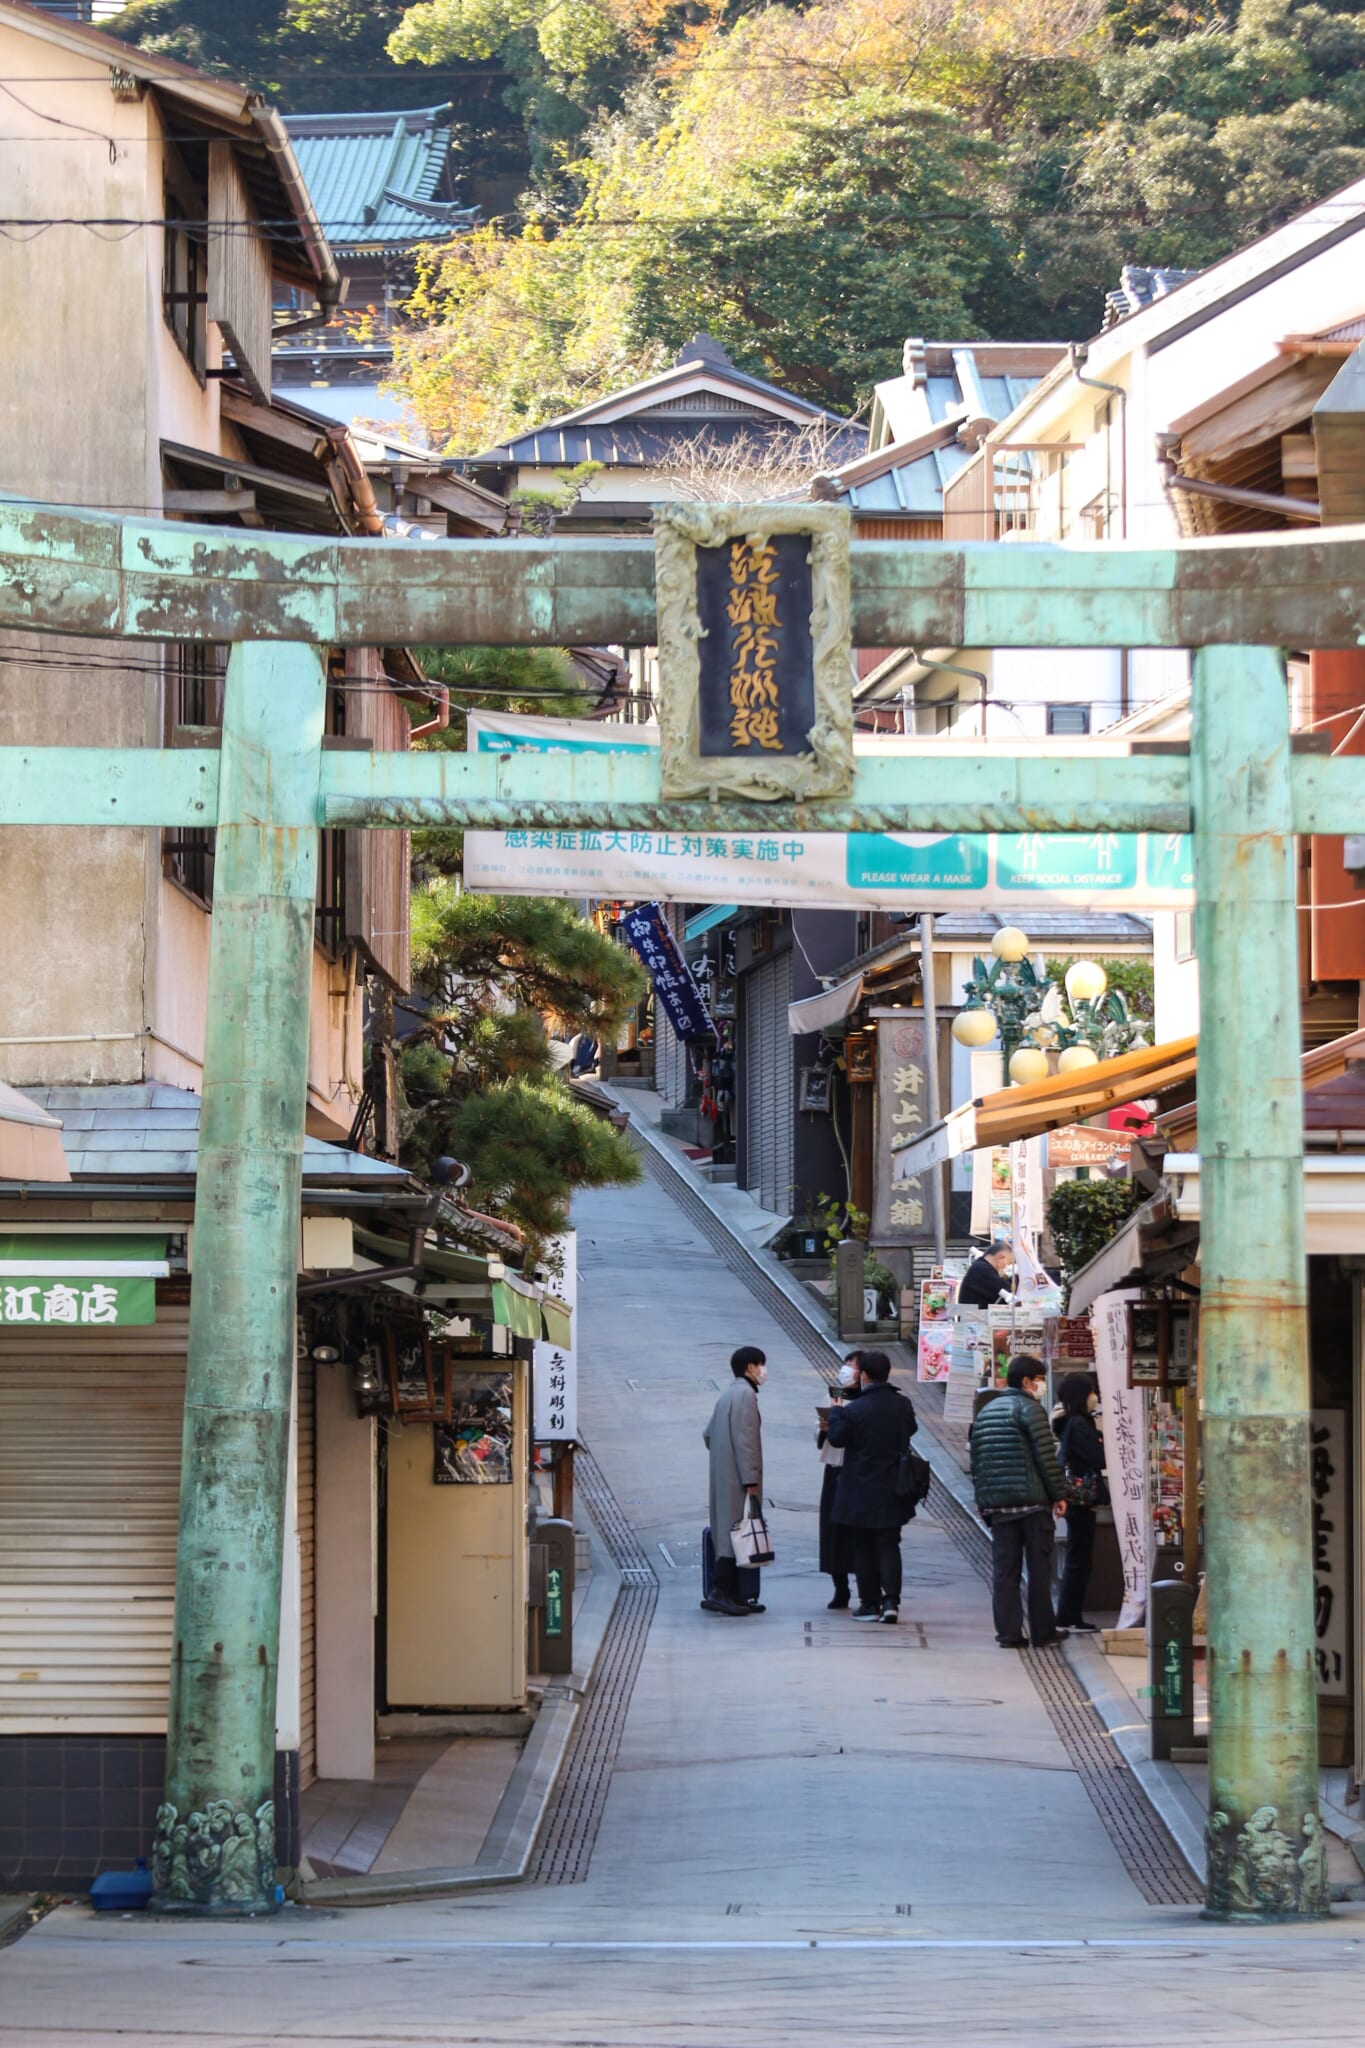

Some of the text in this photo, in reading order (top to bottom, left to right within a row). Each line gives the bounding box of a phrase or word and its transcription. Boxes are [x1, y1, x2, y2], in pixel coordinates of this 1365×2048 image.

[504, 831, 805, 863] 感染症拡大防止対策実施中
[861, 872, 973, 884] PLEASE WEAR A MASK
[0, 1284, 119, 1323] 江商店
